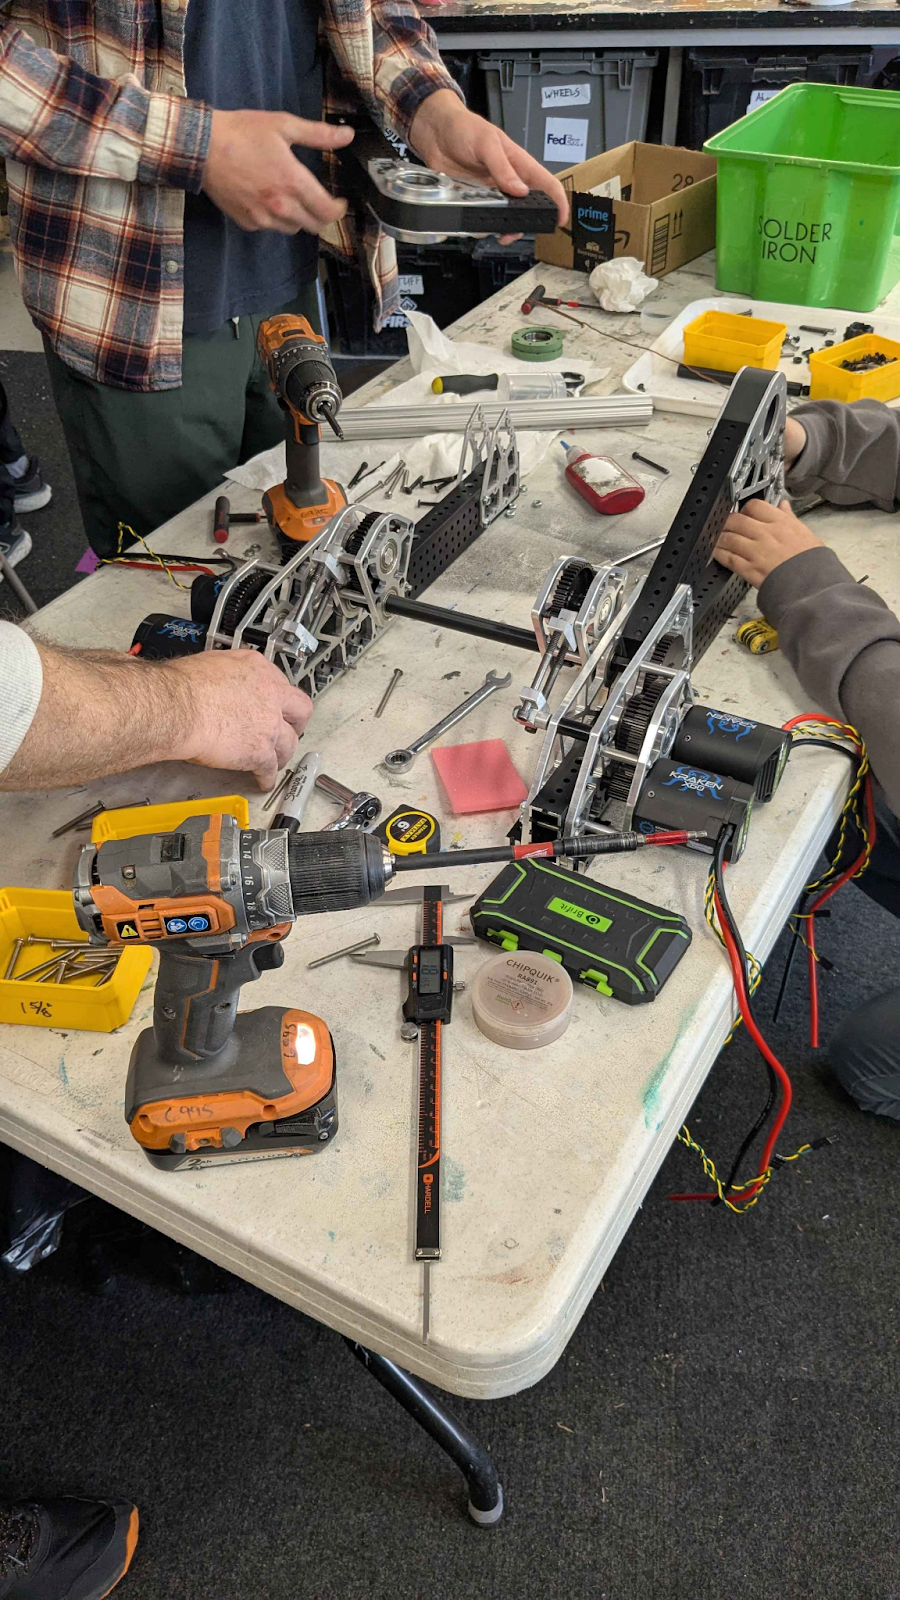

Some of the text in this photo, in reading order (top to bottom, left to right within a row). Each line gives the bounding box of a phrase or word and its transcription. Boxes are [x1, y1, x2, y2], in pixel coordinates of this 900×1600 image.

[544, 88, 580, 100] WHEELS
[577, 206, 609, 221] prime
[758, 215, 832, 243] SOLDER
[762, 240, 817, 264] IRON
[398, 277, 420, 286] TUFF
[669, 770, 724, 790] KRAKEN
[681, 780, 705, 792] X60
[243, 850, 252, 859] 14
[244, 875, 254, 886] 16
[246, 902, 256, 911] 18
[560, 903, 585, 918] Brifit
[517, 973, 538, 985] RA891
[165, 1104, 214, 1123] 6995
